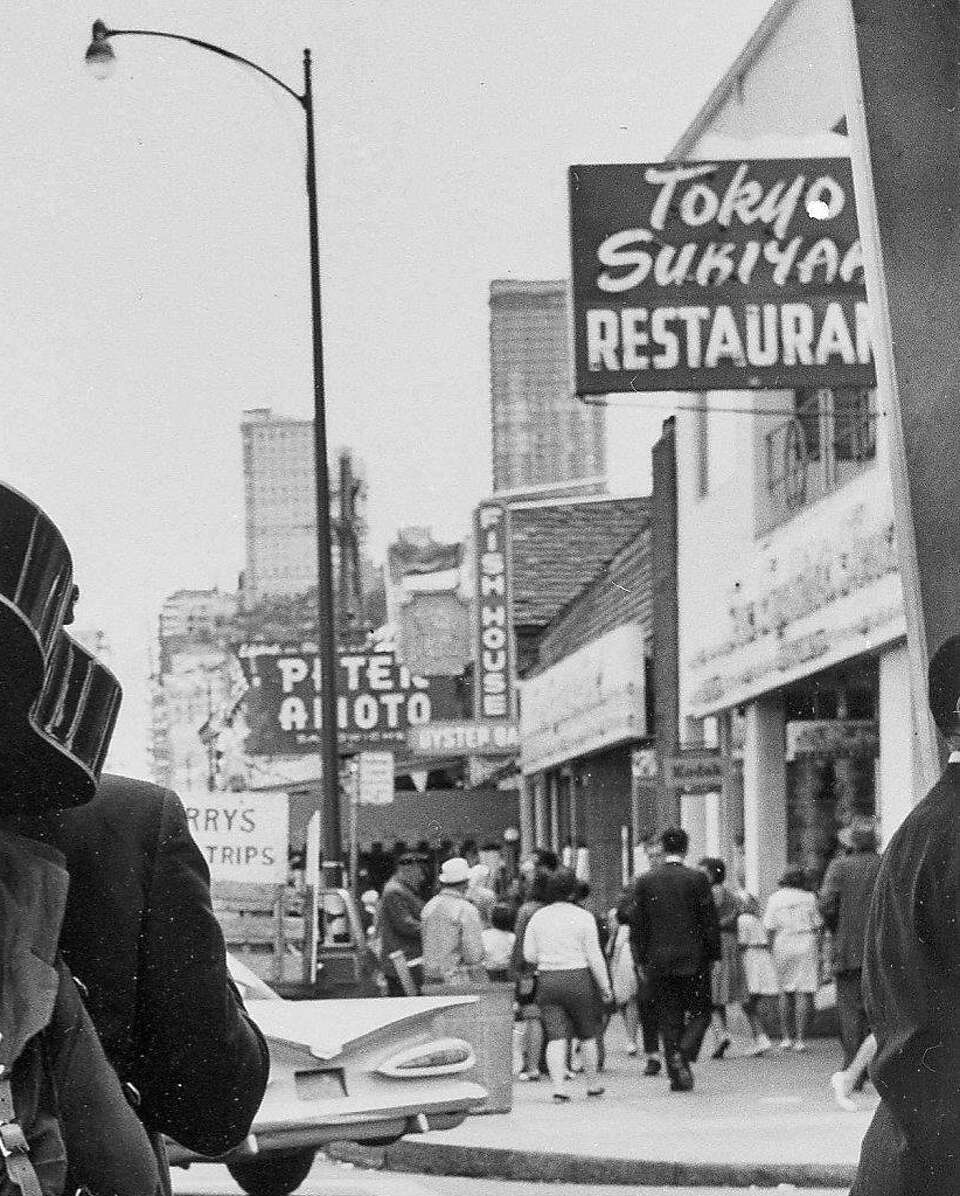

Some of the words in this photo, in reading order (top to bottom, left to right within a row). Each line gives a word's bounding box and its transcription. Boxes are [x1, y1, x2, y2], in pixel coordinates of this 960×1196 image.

[480, 505, 506, 597] FISH
[482, 605, 508, 717] HOUSE
[205, 845, 276, 866] TRIPS
